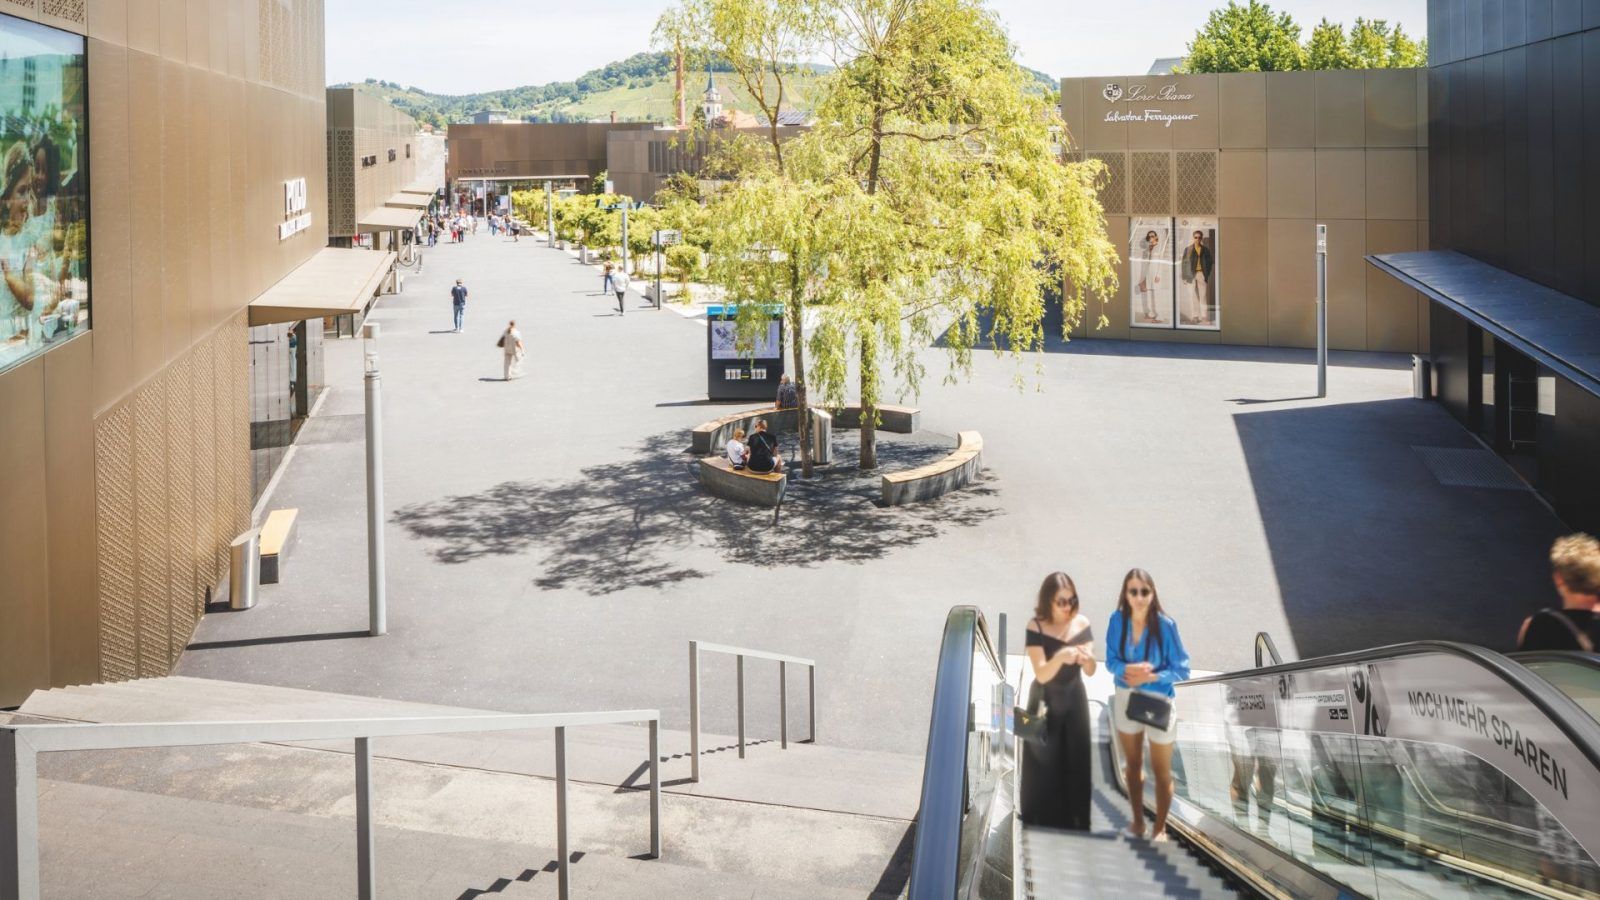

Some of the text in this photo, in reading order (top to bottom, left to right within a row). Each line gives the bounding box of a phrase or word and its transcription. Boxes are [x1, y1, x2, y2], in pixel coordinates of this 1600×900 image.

[1123, 82, 1195, 101] Loro Piana
[1104, 109, 1198, 127] Salvatore Ferragamo
[1407, 691, 1568, 801] NOCH MEHR SPAREN
